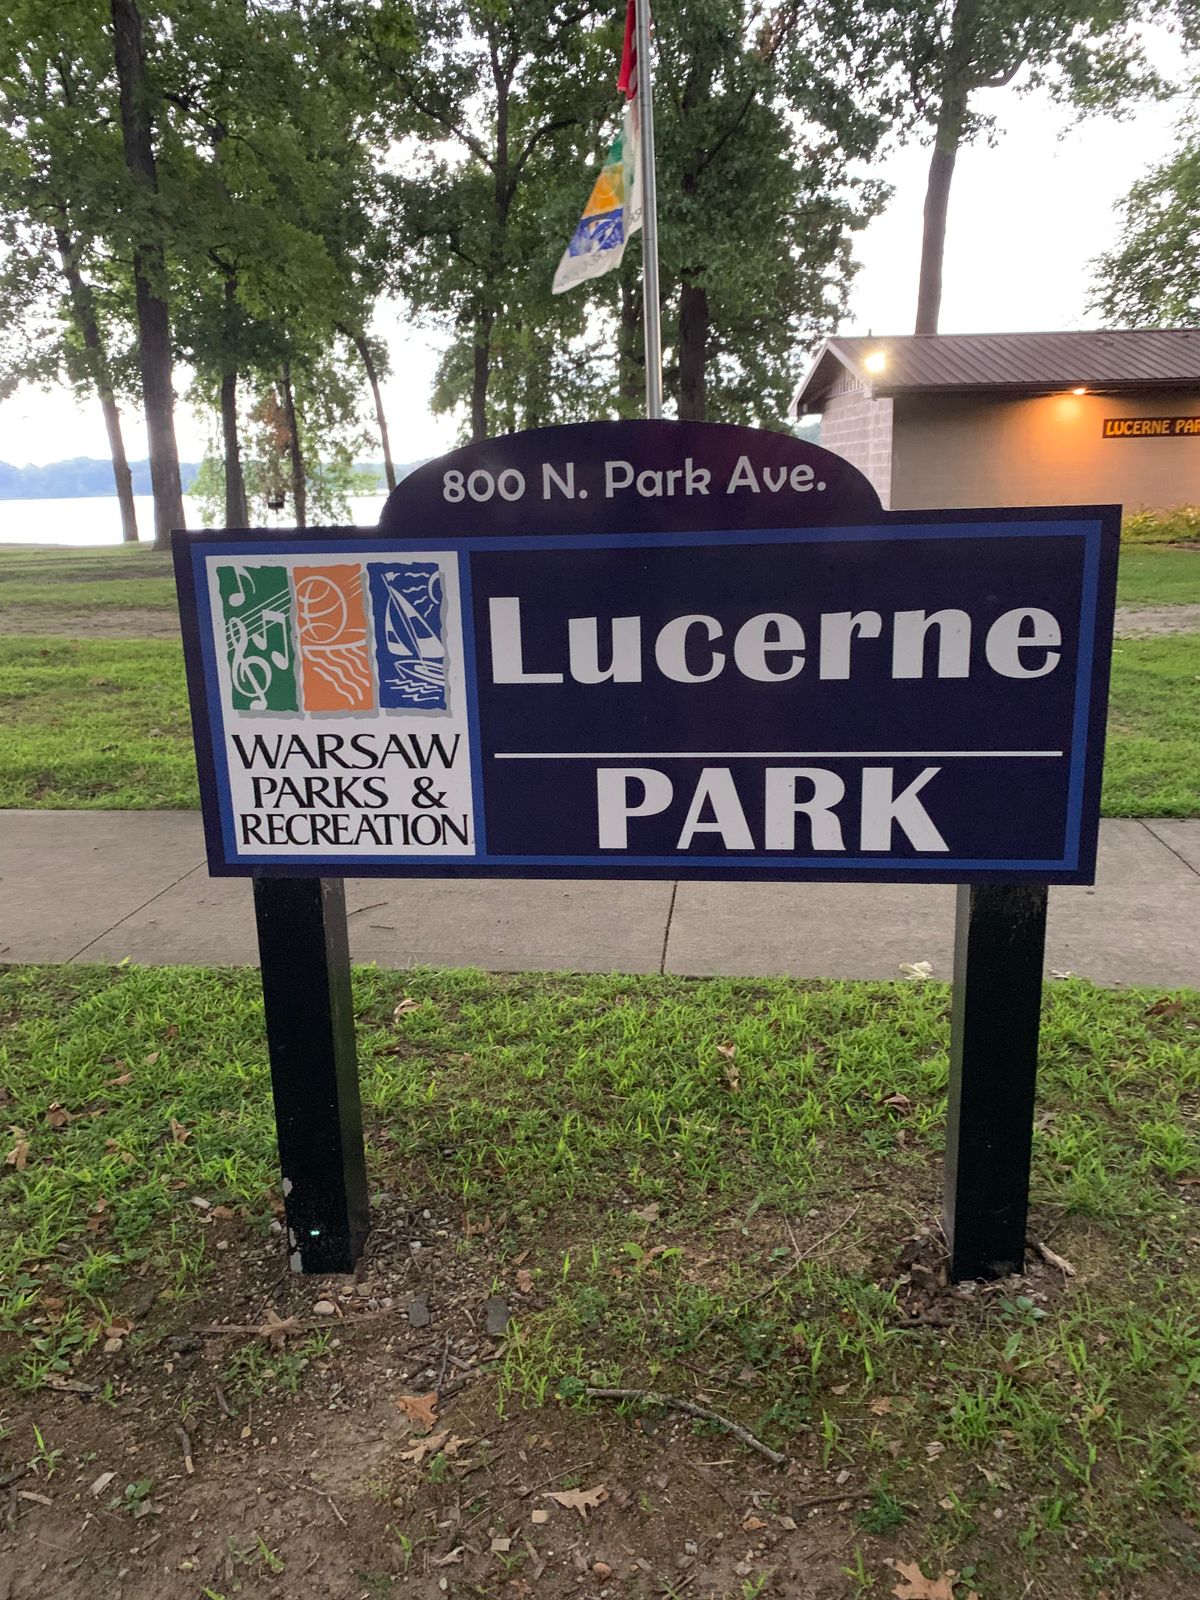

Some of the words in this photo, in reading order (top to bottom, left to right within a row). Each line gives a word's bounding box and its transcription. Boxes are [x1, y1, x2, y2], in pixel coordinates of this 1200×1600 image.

[1106, 421, 1169, 435] LUCERNE
[443, 469, 526, 503] 800
[542, 462, 588, 500] N.
[605, 457, 711, 498] Park
[726, 455, 827, 495] Ave.
[488, 596, 1063, 685] Lucerne
[231, 733, 461, 770] WARSAW
[250, 776, 389, 809] PARKS
[411, 776, 448, 809] &
[596, 767, 951, 852] PARK
[239, 813, 469, 846] RECREATION
